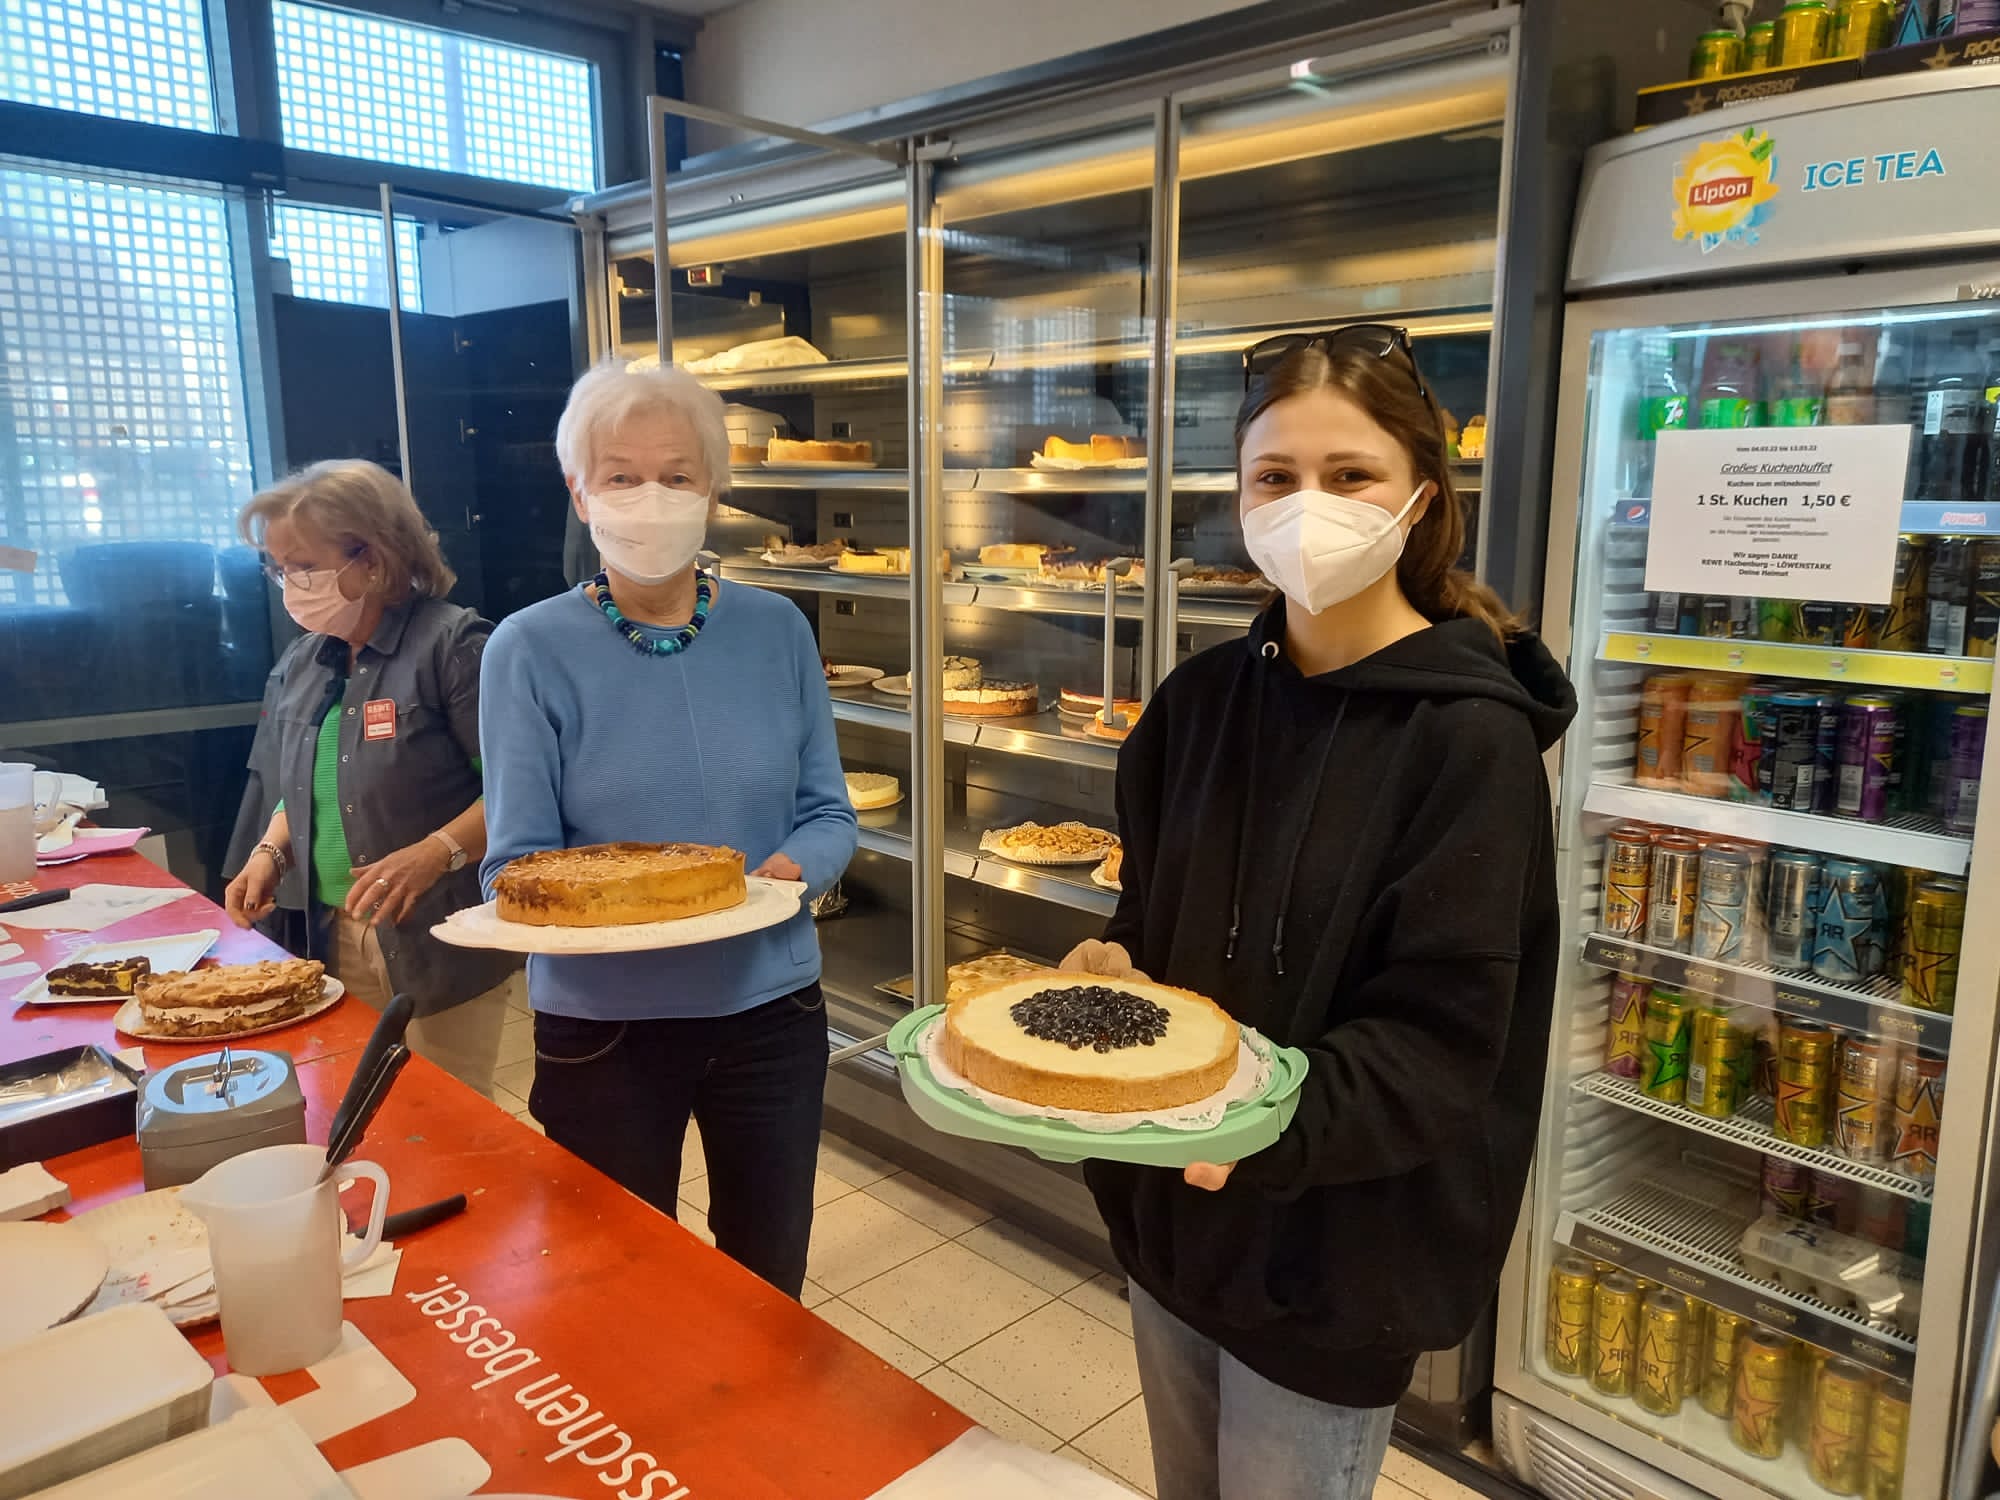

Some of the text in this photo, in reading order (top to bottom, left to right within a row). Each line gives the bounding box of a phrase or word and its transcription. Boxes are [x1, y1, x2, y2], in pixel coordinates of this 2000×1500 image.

[1802, 148, 1945, 192] ICE TEA
[1692, 181, 1748, 203] Lipton
[1720, 462, 1833, 475] Großes Kuchenbuffet
[1697, 494, 1852, 509] 1 St. Kuchen 1,50 €
[1724, 559, 1768, 568] Hachenburg
[1776, 561, 1832, 570] LÖWENSTARK
[404, 1274, 541, 1391] besser.
